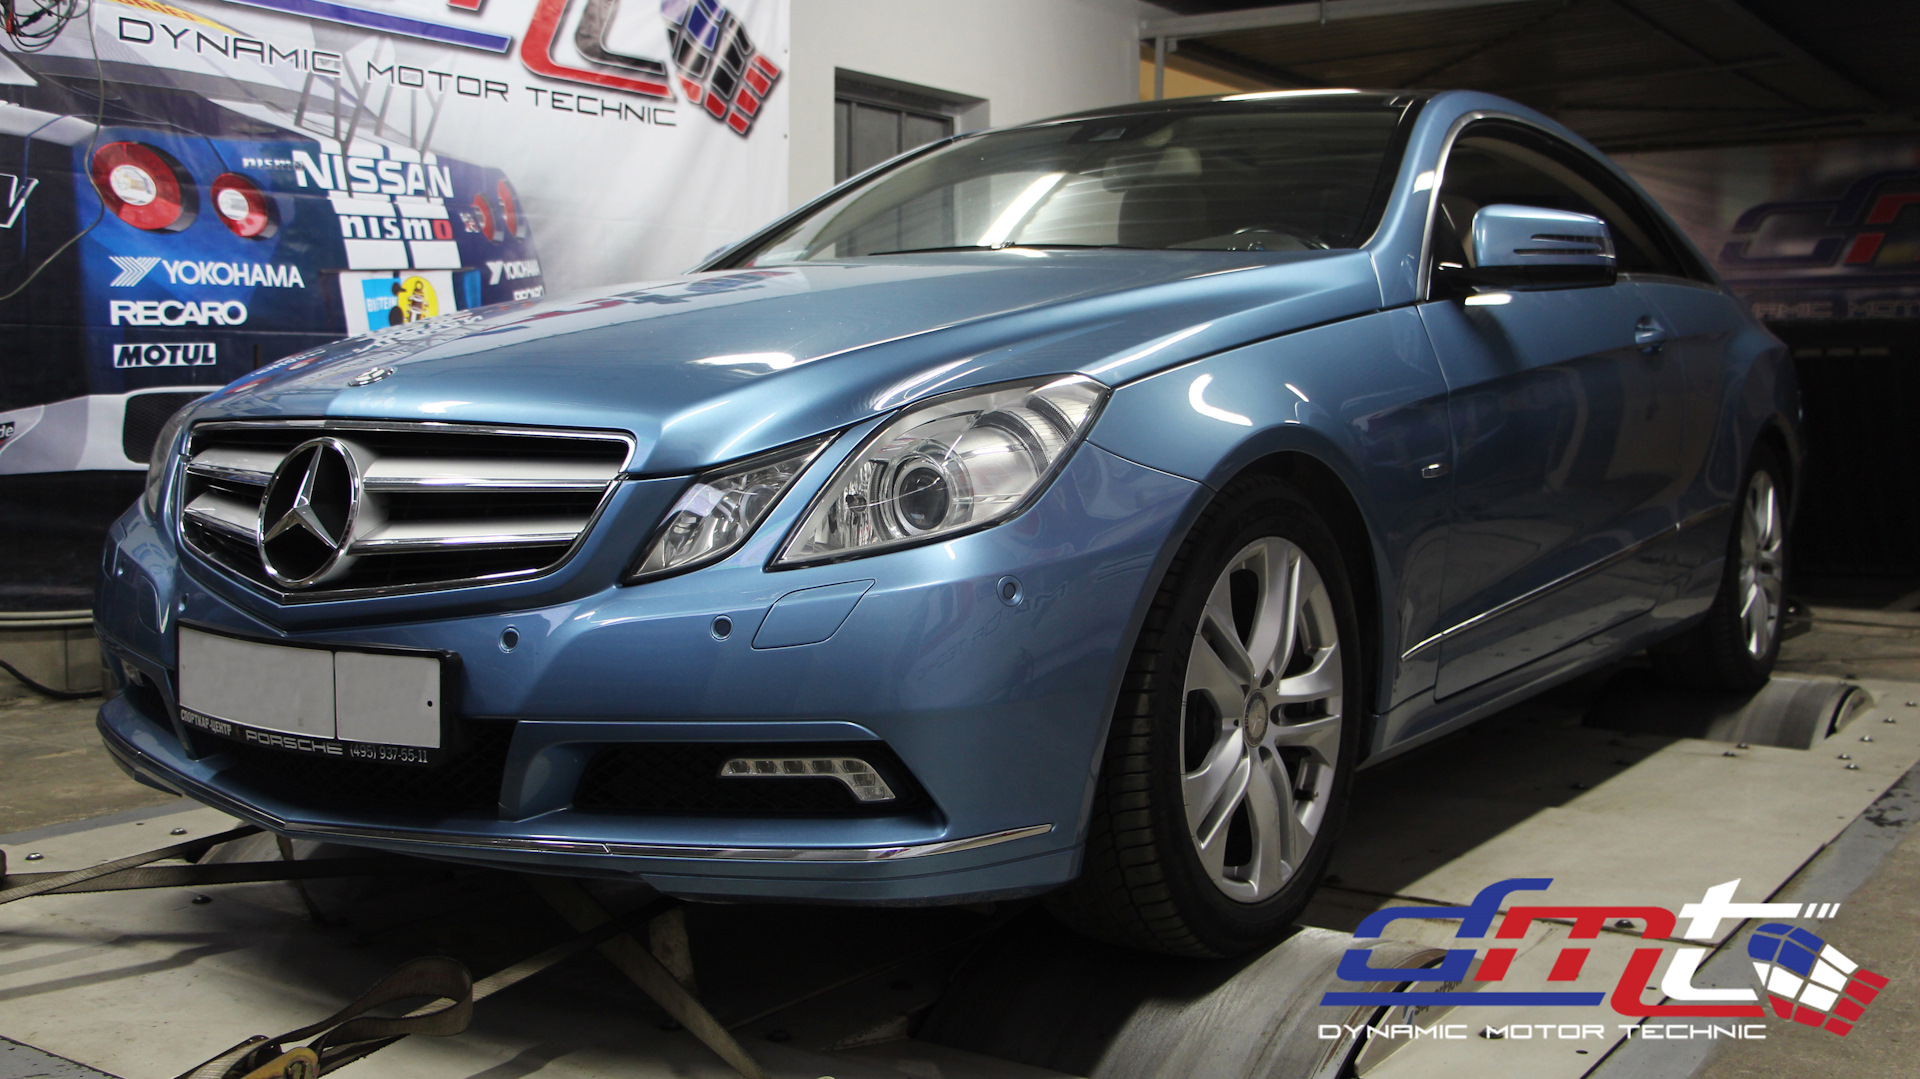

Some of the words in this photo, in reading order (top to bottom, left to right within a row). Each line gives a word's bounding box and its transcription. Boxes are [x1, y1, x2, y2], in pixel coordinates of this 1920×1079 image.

[118, 16, 341, 76] DYNAMIC
[367, 60, 509, 102] MOTOR
[525, 86, 677, 127] TECHNIC
[292, 149, 454, 198] NISSAN
[338, 214, 453, 240] nismo
[161, 259, 305, 289] YOKOHAMA
[109, 299, 248, 326] RECARO
[116, 344, 215, 367] MOTUL
[245, 729, 343, 755] PORSCHE
[350, 744, 377, 759] (495)
[379, 746, 428, 763] 937-55-11
